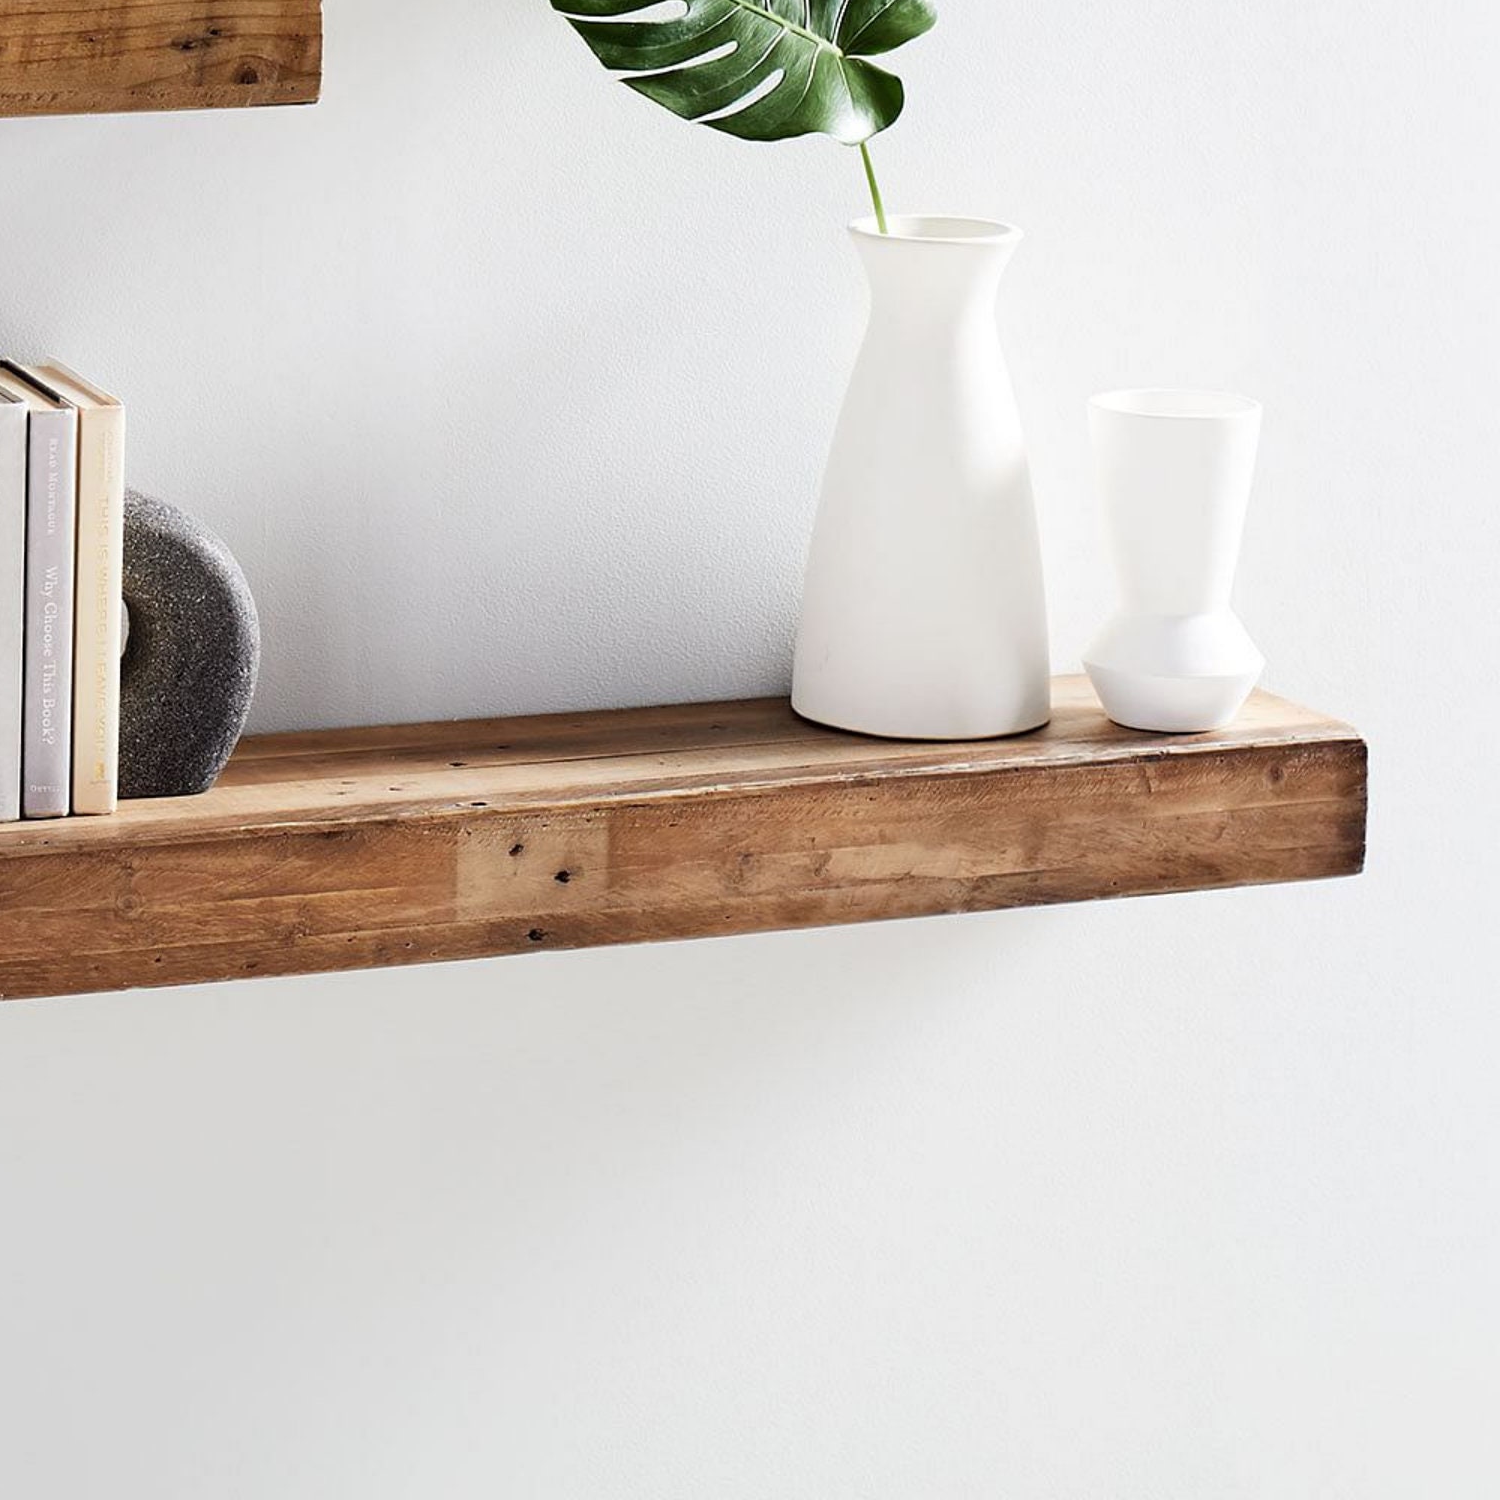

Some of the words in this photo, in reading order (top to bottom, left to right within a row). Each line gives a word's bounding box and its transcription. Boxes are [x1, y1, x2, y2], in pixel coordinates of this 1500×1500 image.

[99, 496, 109, 536] THIS
[41, 565, 59, 599] Why
[96, 565, 108, 634] WHERE
[43, 601, 59, 658] Choose
[42, 660, 58, 694] This
[41, 698, 57, 745] Book?
